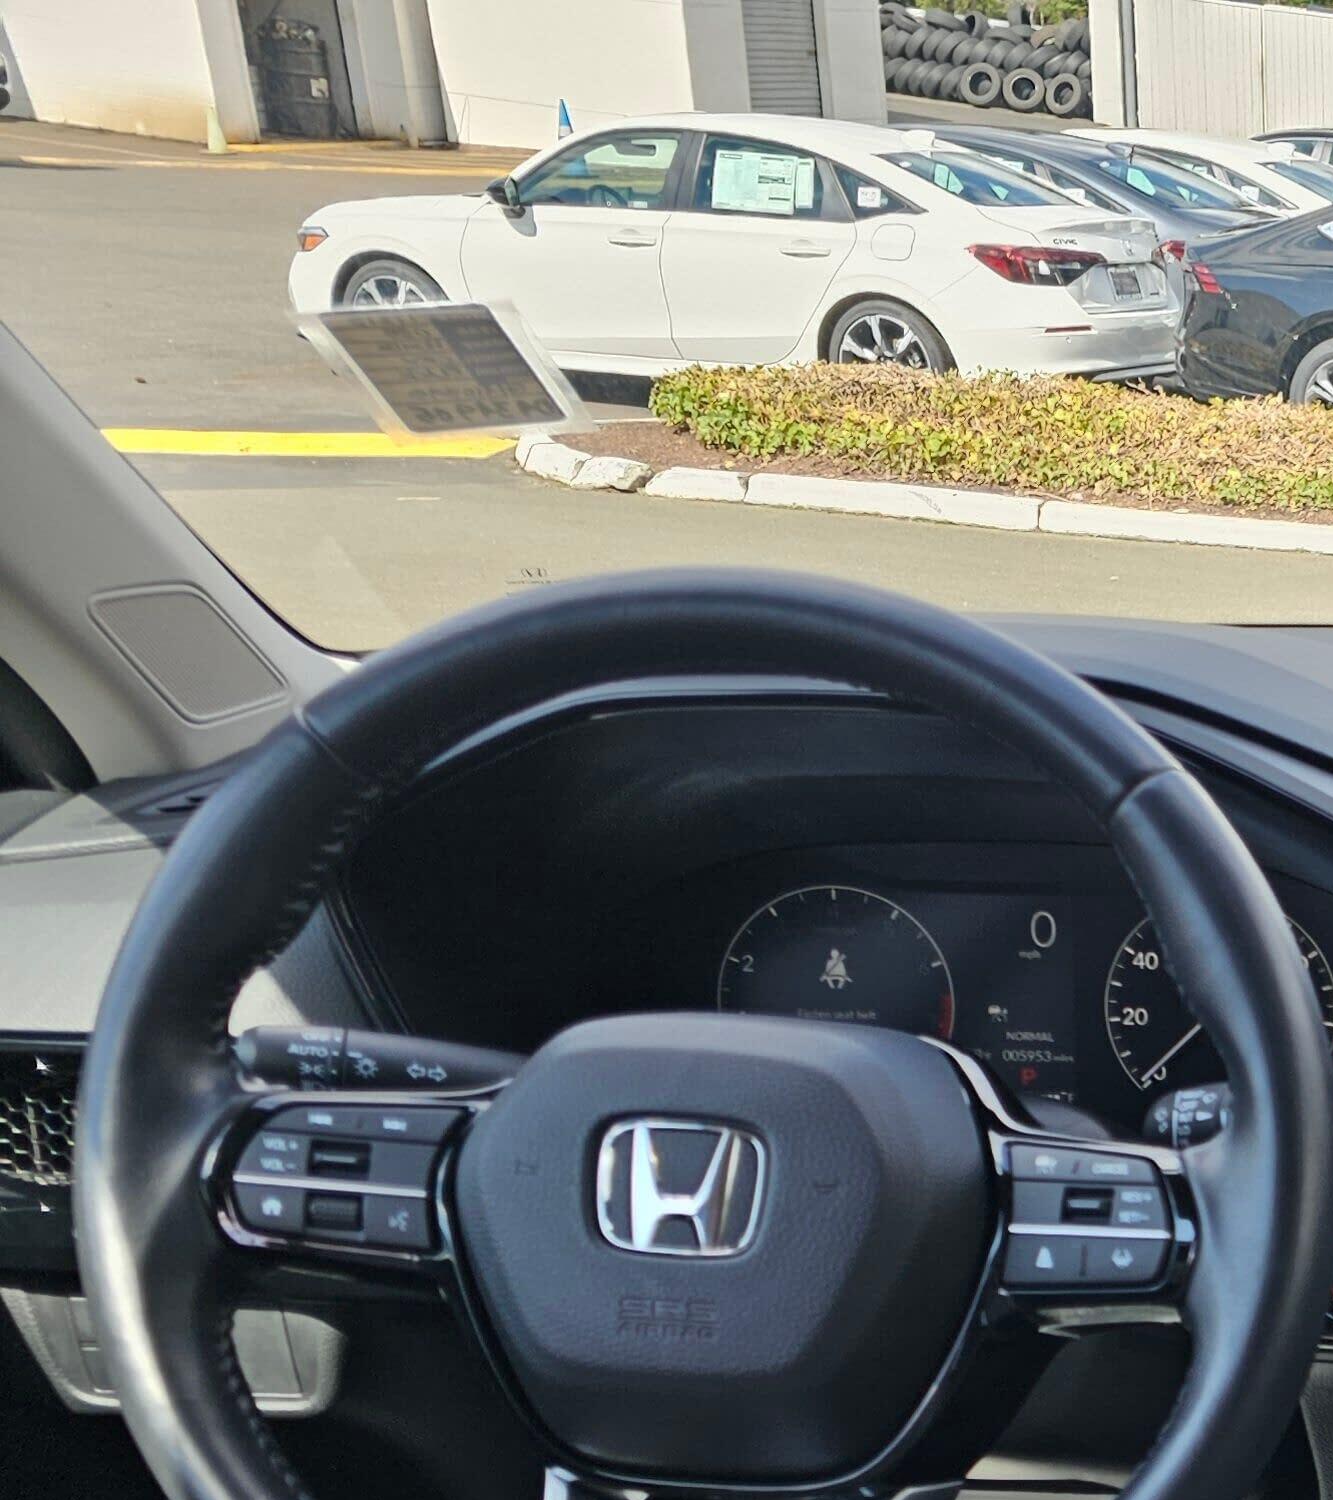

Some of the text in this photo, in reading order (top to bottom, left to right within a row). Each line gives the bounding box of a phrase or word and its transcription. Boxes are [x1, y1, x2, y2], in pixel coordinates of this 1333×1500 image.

[1031, 911, 1056, 947] 0
[742, 955, 754, 972] 2
[1132, 952, 1159, 970] 40
[1122, 1007, 1148, 1026] 20
[1006, 1031, 1054, 1042] NORMAL
[287, 1044, 328, 1057] AUTO
